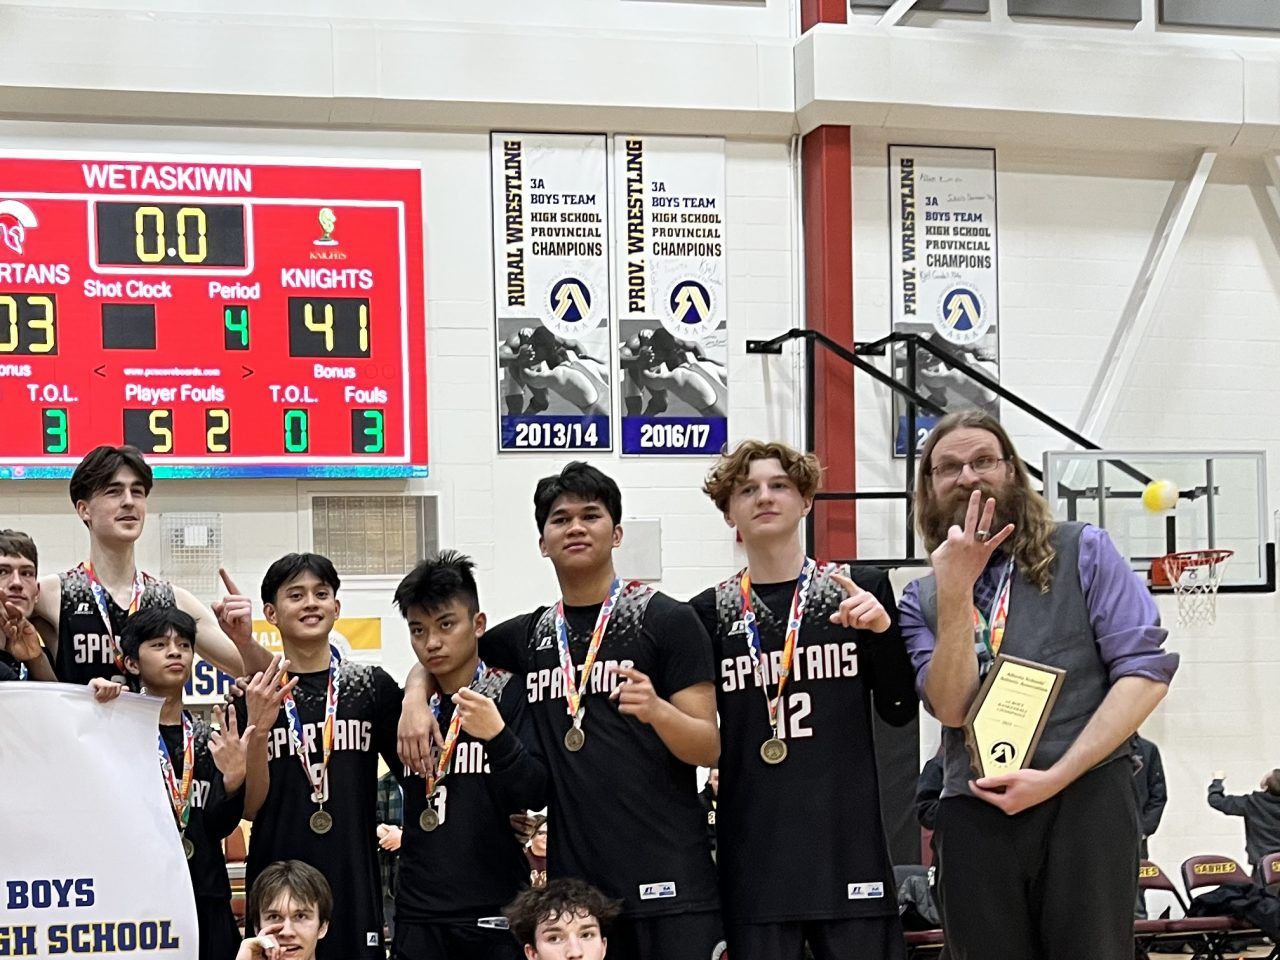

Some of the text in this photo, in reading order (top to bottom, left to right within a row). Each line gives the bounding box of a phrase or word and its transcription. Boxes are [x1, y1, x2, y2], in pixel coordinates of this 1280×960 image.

[82, 163, 252, 192] WETASKIWIN
[530, 179, 545, 189] 3A
[652, 182, 666, 192] 3A
[530, 194, 596, 205] BOYS TEAM
[652, 197, 716, 208] BOYS TEAM
[926, 197, 938, 206] 3A
[504, 140, 526, 306] RURAL WRESTLING
[531, 212, 602, 223] HIGH SCHOOL
[626, 140, 645, 312] PROV. WRESTLING
[652, 212, 721, 224] HIGH SCHOOL
[926, 212, 982, 222] BOYS TEAM
[135, 206, 207, 263] 0.0
[531, 227, 601, 238] PROVINCIAL
[652, 228, 720, 238] PROVINCIAL
[900, 158, 916, 314] PROV. WRESTLING
[926, 226, 990, 237] HIGH SCHOOL
[532, 242, 602, 256] CHAMPIONS
[653, 242, 722, 257] CHAMPIONS
[926, 241, 990, 250] PROVINCIAL
[926, 254, 991, 268] CHAMPIONS
[281, 269, 373, 289] KNIGHTS
[84, 280, 172, 299] Shot Clock
[209, 282, 260, 300] Period
[224, 309, 248, 346] 4
[304, 303, 368, 353] 41
[314, 364, 356, 379] Bonus
[28, 384, 78, 402] T.O.L.
[125, 384, 224, 405] Player Fouls
[269, 385, 318, 403] T.O.L.
[345, 386, 387, 404] Fouls
[46, 409, 67, 452] 3
[149, 410, 172, 453] 5
[206, 409, 229, 453] 2
[285, 410, 307, 453] 0
[364, 410, 383, 453] 3
[516, 423, 598, 446] 2013/14
[640, 424, 710, 448] 2016/17
[721, 642, 858, 692] SPARTANS
[1194, 862, 1237, 874] SABRES
[7, 878, 95, 910] BOYS
[48, 920, 179, 954] SCHOOL
